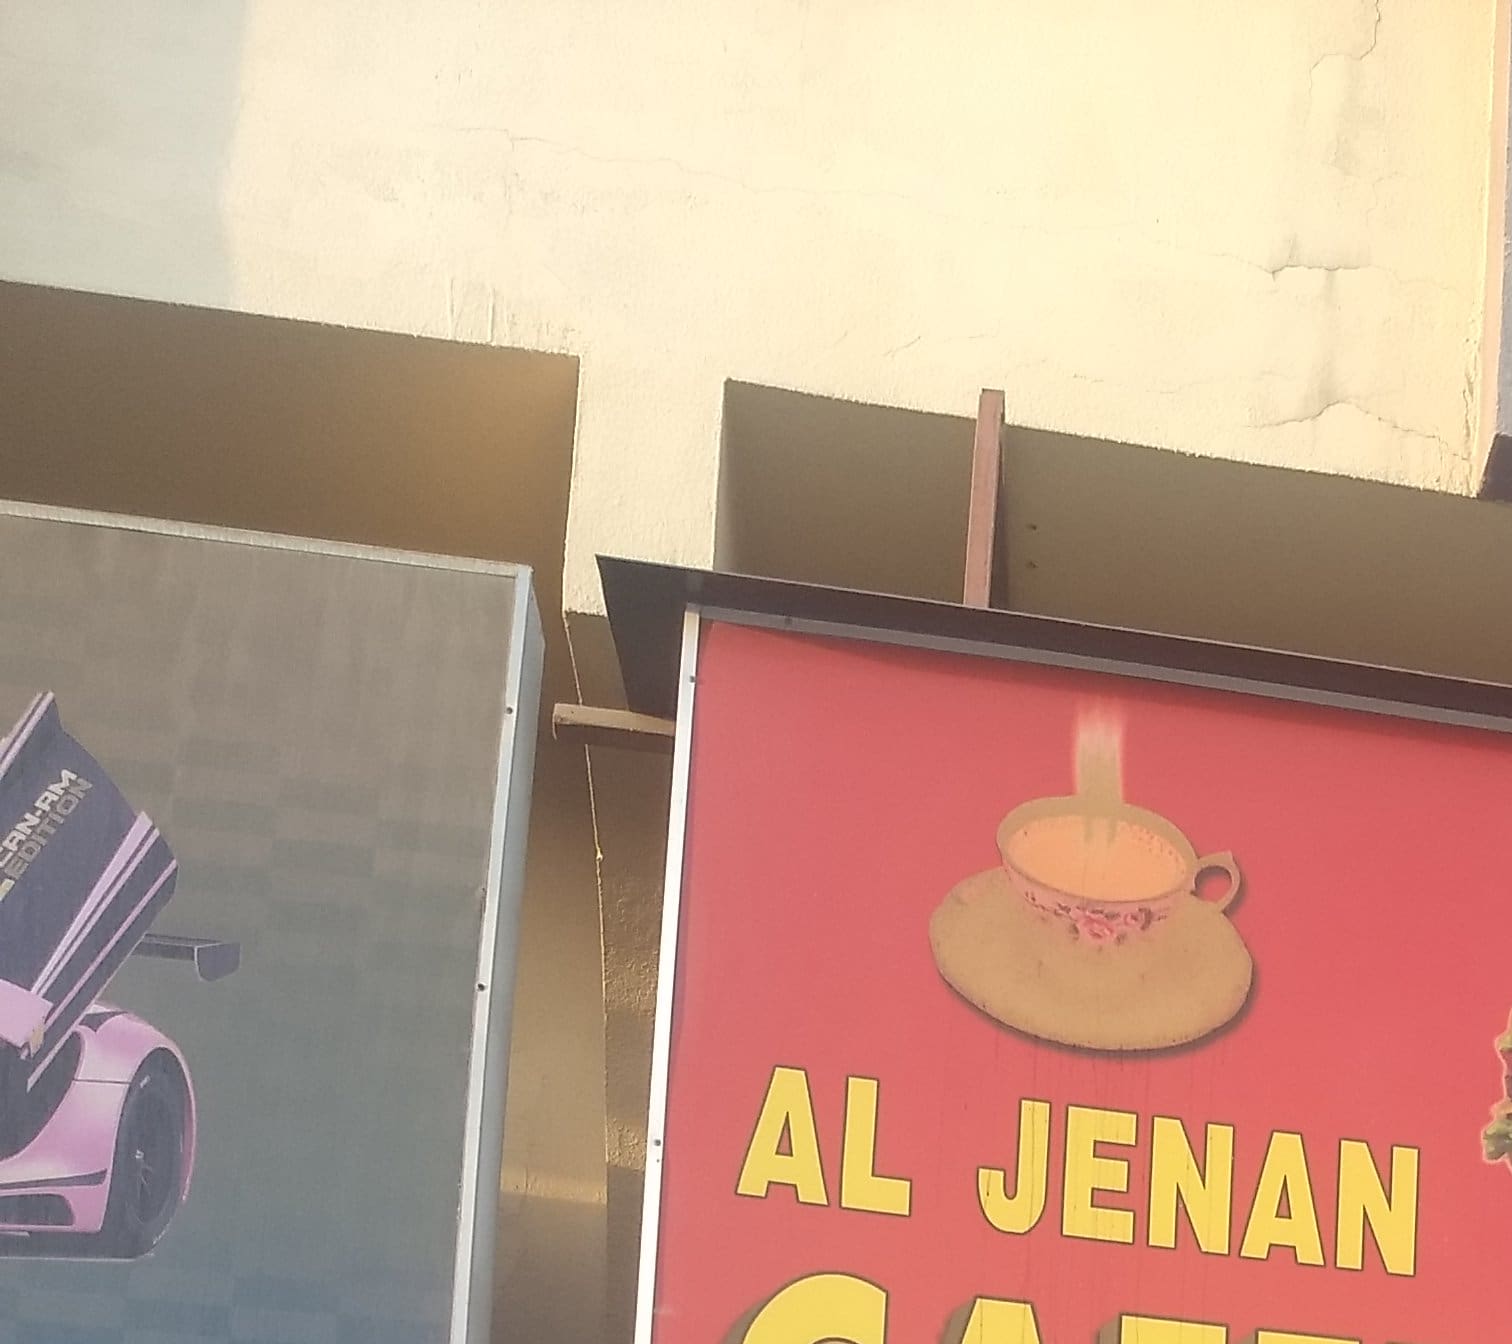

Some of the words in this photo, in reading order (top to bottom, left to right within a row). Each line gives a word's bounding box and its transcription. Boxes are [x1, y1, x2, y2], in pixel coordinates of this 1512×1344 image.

[4, 777, 93, 880] EDITION
[736, 1065, 912, 1217] AL
[976, 1098, 1421, 1277] JENAN
